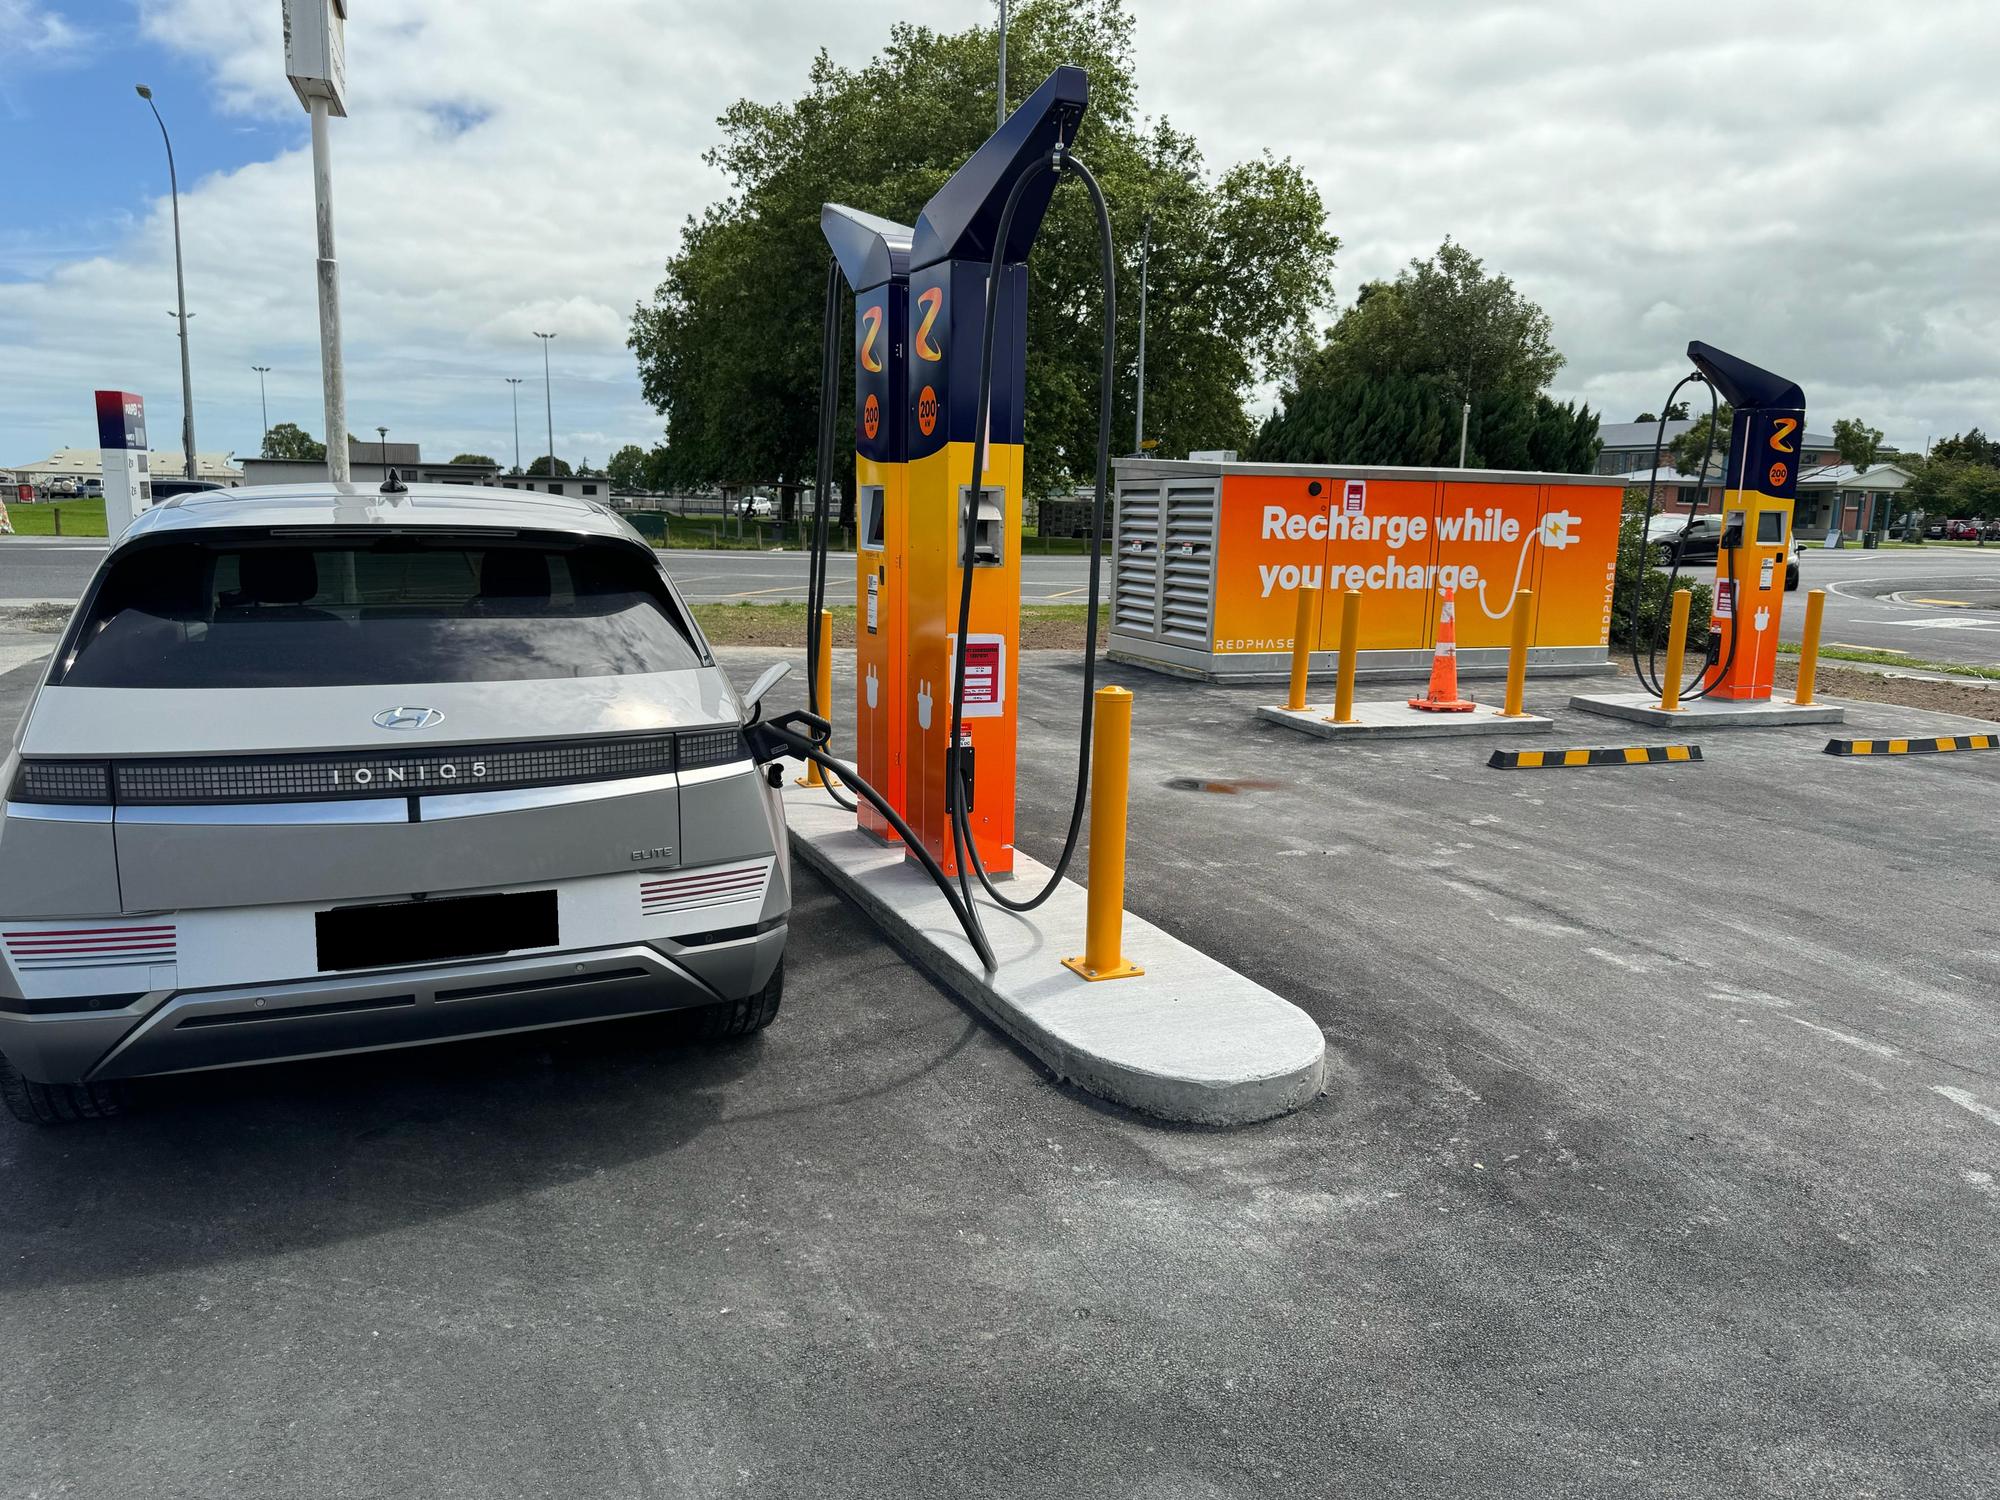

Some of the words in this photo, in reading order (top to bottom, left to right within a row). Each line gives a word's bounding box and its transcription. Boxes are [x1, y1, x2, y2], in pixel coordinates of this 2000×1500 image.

[865, 406, 879, 424] 200
[920, 400, 936, 419] 200
[1770, 469, 1787, 479] 200
[1261, 505, 1427, 549] Recharge
[1434, 507, 1520, 543] while
[1258, 564, 1323, 598] you
[1600, 563, 1616, 645] REDPHASE
[1215, 638, 1295, 650] REDPHASE
[333, 763, 457, 786] IONIQ
[472, 761, 487, 778] 5
[631, 846, 673, 861] ELITE
